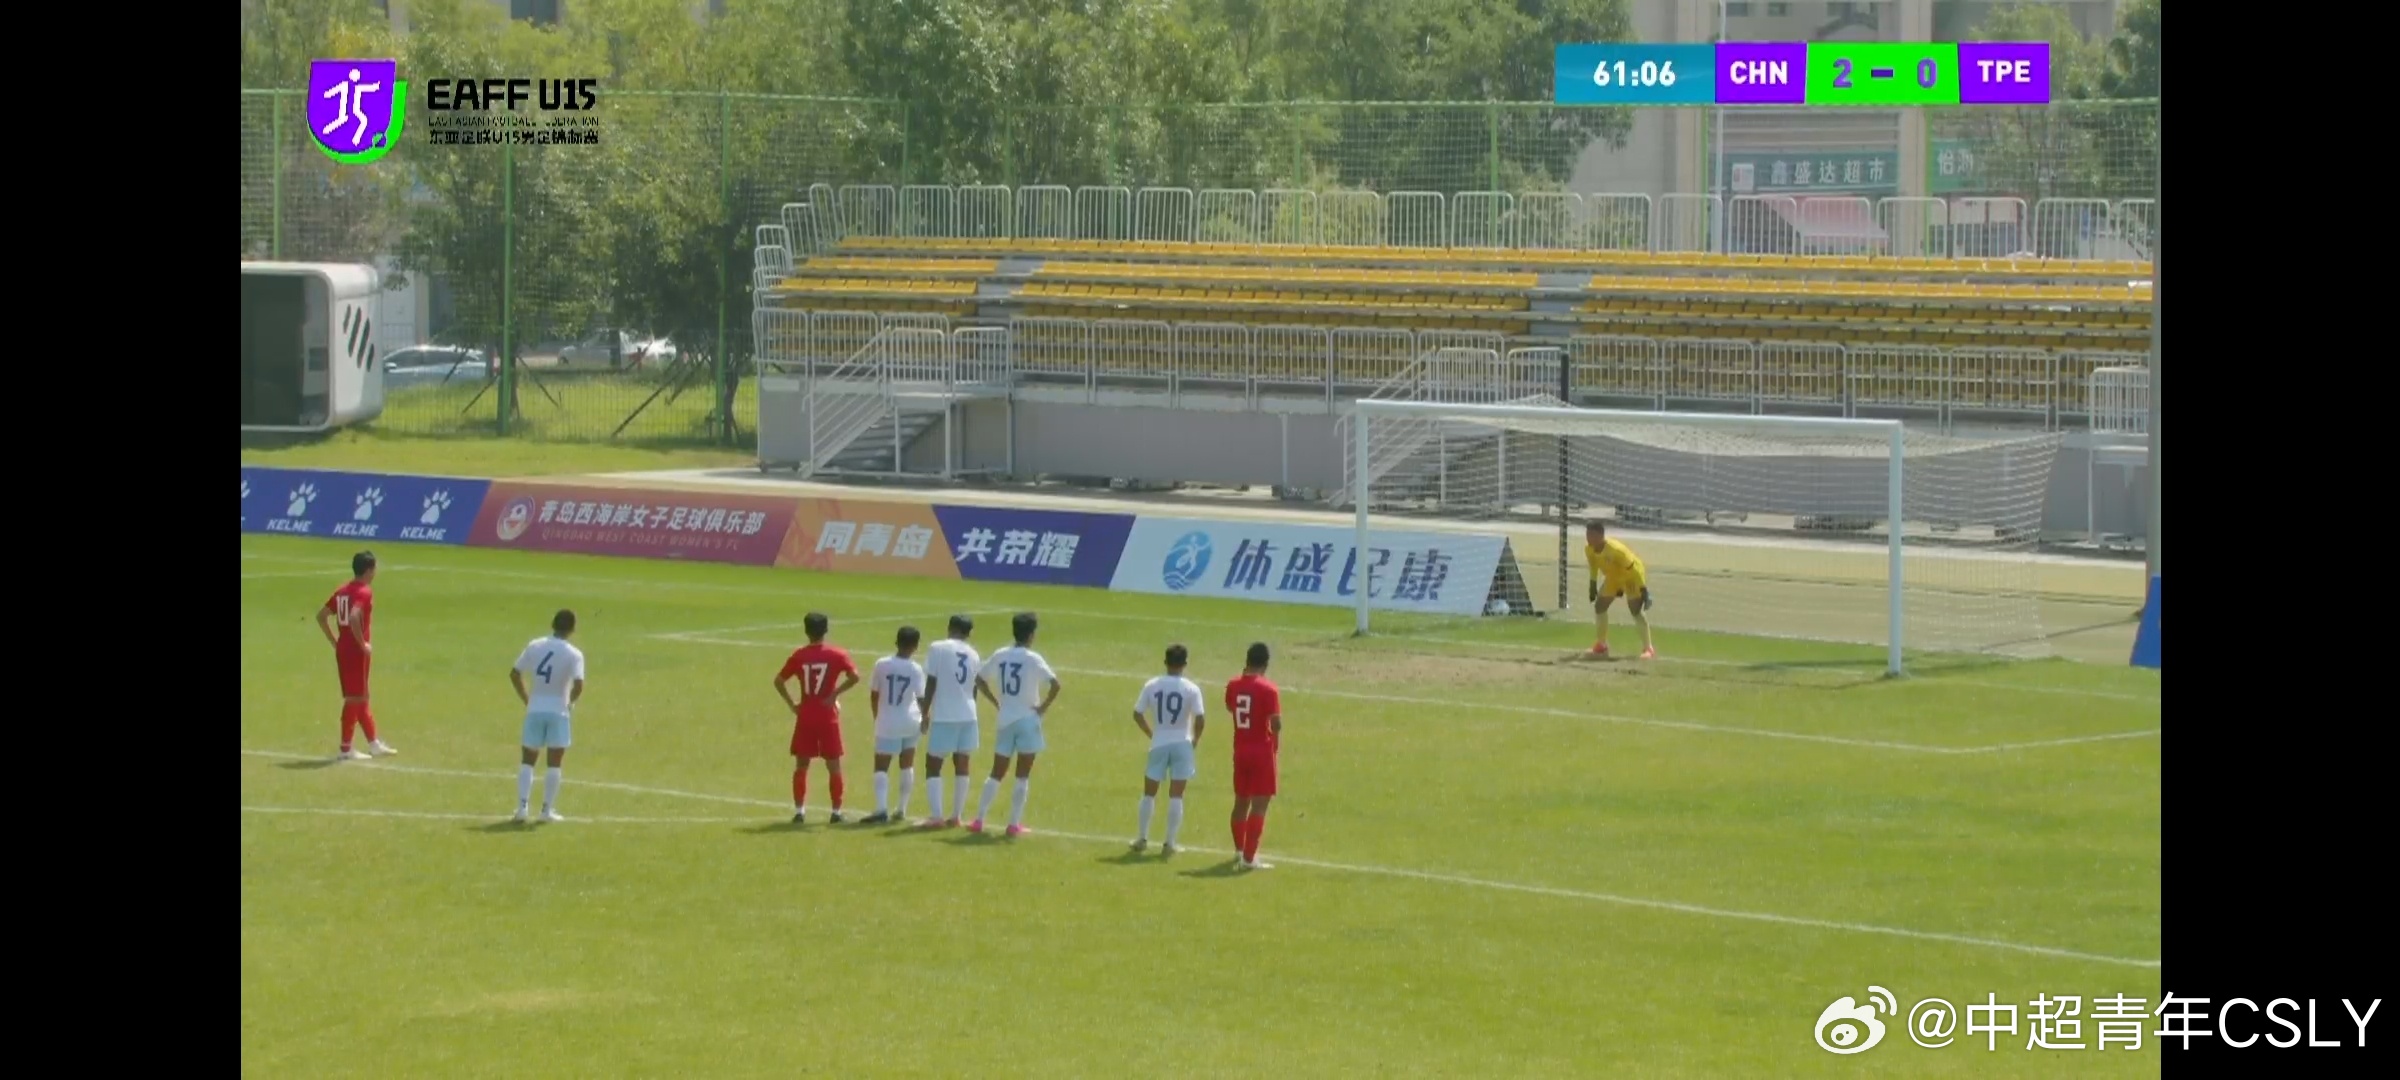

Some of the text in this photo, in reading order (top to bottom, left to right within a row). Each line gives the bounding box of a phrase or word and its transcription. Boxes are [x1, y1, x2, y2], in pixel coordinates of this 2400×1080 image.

[1770, 158, 1885, 185] 鑫盛达超市
[266, 519, 312, 532] KELME
[333, 523, 379, 536] KELME
[401, 527, 446, 540] KELME
[538, 500, 765, 534] 青岛西海岸女子足球俱乐部
[542, 529, 591, 542] QINGDAO
[596, 531, 626, 543] WEST
[630, 533, 666, 546] COAST
[815, 521, 933, 560] 同青岛
[956, 527, 1080, 568] 共荣耀
[336, 595, 349, 626] 10
[536, 651, 554, 684] 4
[802, 662, 828, 696] 17
[955, 652, 968, 685] 3
[999, 661, 1022, 697] 13
[886, 674, 910, 706] 17
[1154, 691, 1183, 725] 19
[1236, 694, 1251, 729] 2
